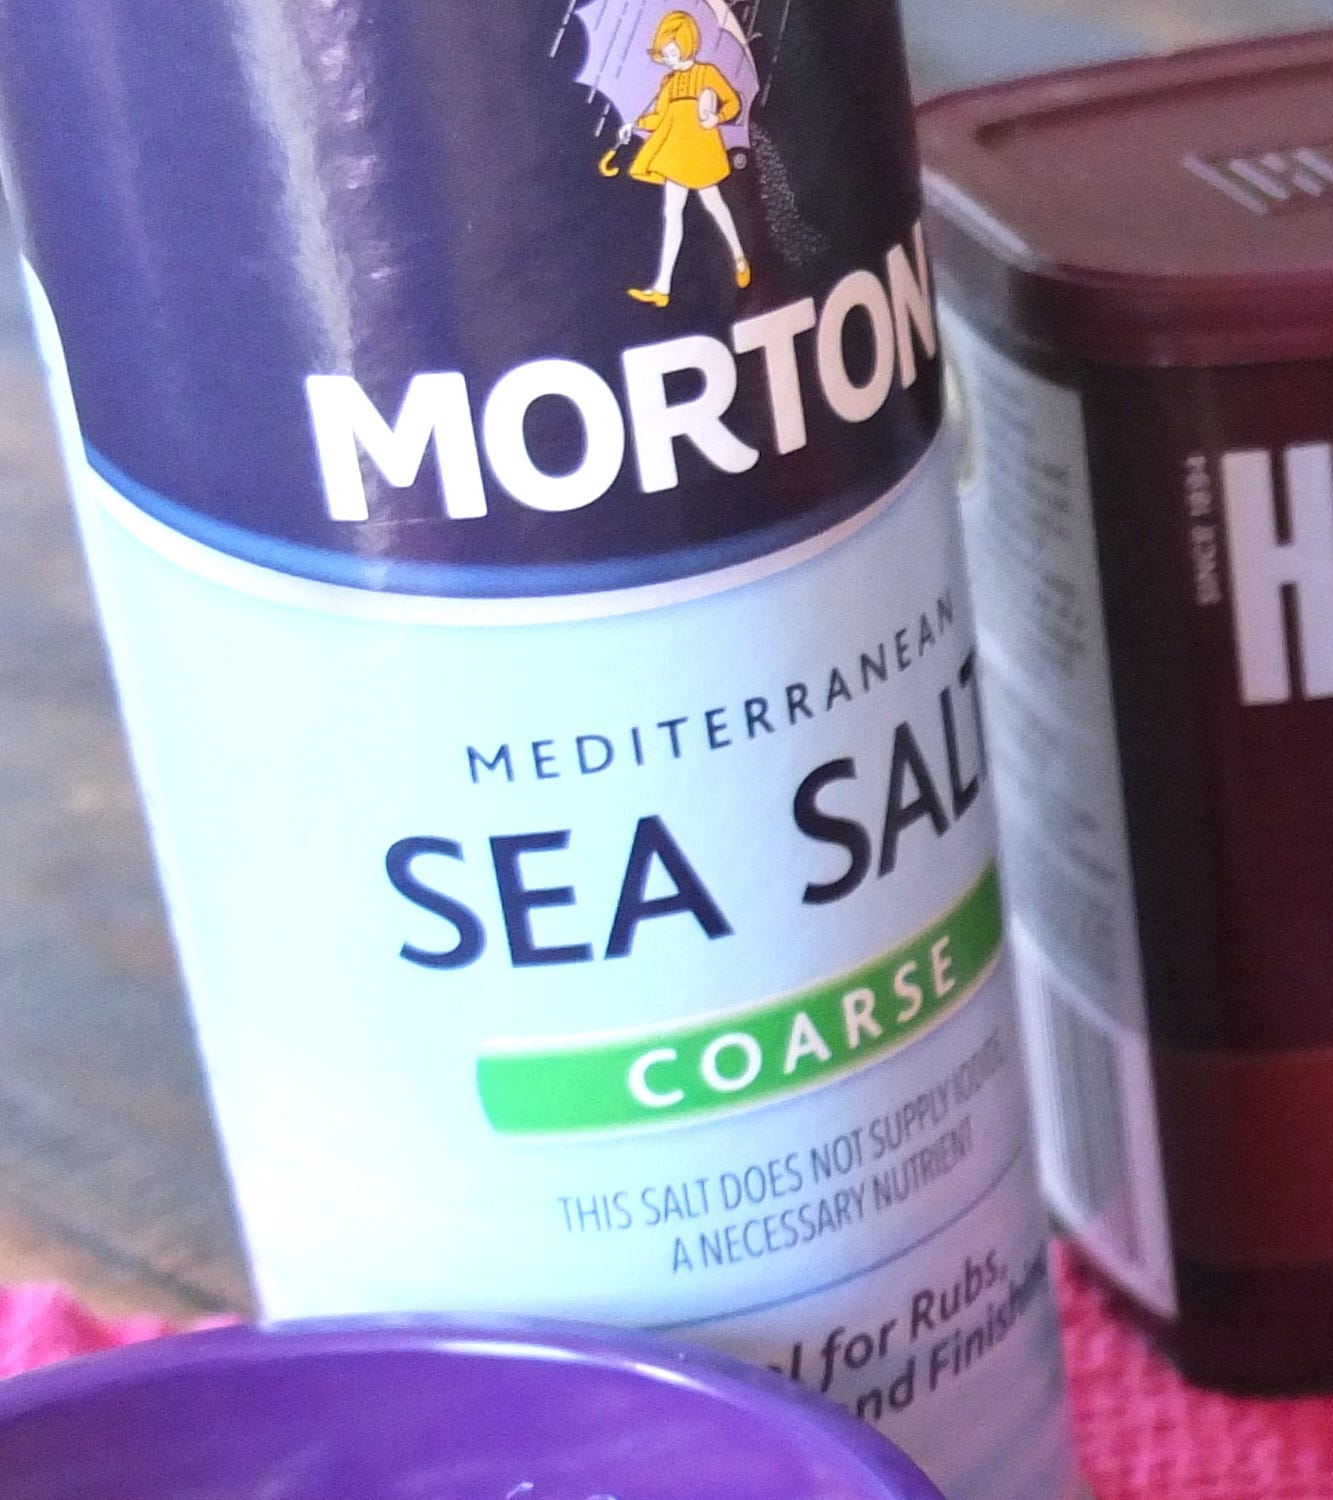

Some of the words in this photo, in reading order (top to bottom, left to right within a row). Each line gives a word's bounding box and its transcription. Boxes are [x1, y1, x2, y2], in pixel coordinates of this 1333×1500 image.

[305, 221, 935, 521] MORTON
[466, 597, 953, 784] MEDITERRANEAN
[385, 814, 734, 971] SEA
[793, 645, 987, 906] SALT
[627, 936, 957, 1107] COARSE
[557, 1189, 634, 1234] THIS
[643, 1177, 710, 1227] SALT
[720, 1152, 802, 1211] DOES
[810, 1129, 865, 1185] NOT
[871, 1088, 951, 1160] SUPPLY
[671, 1237, 694, 1274] A
[701, 1186, 866, 1268] NECESSARY
[874, 1115, 973, 1208] NUTRIENT
[820, 1317, 897, 1393] for
[856, 1354, 917, 1421] nd
